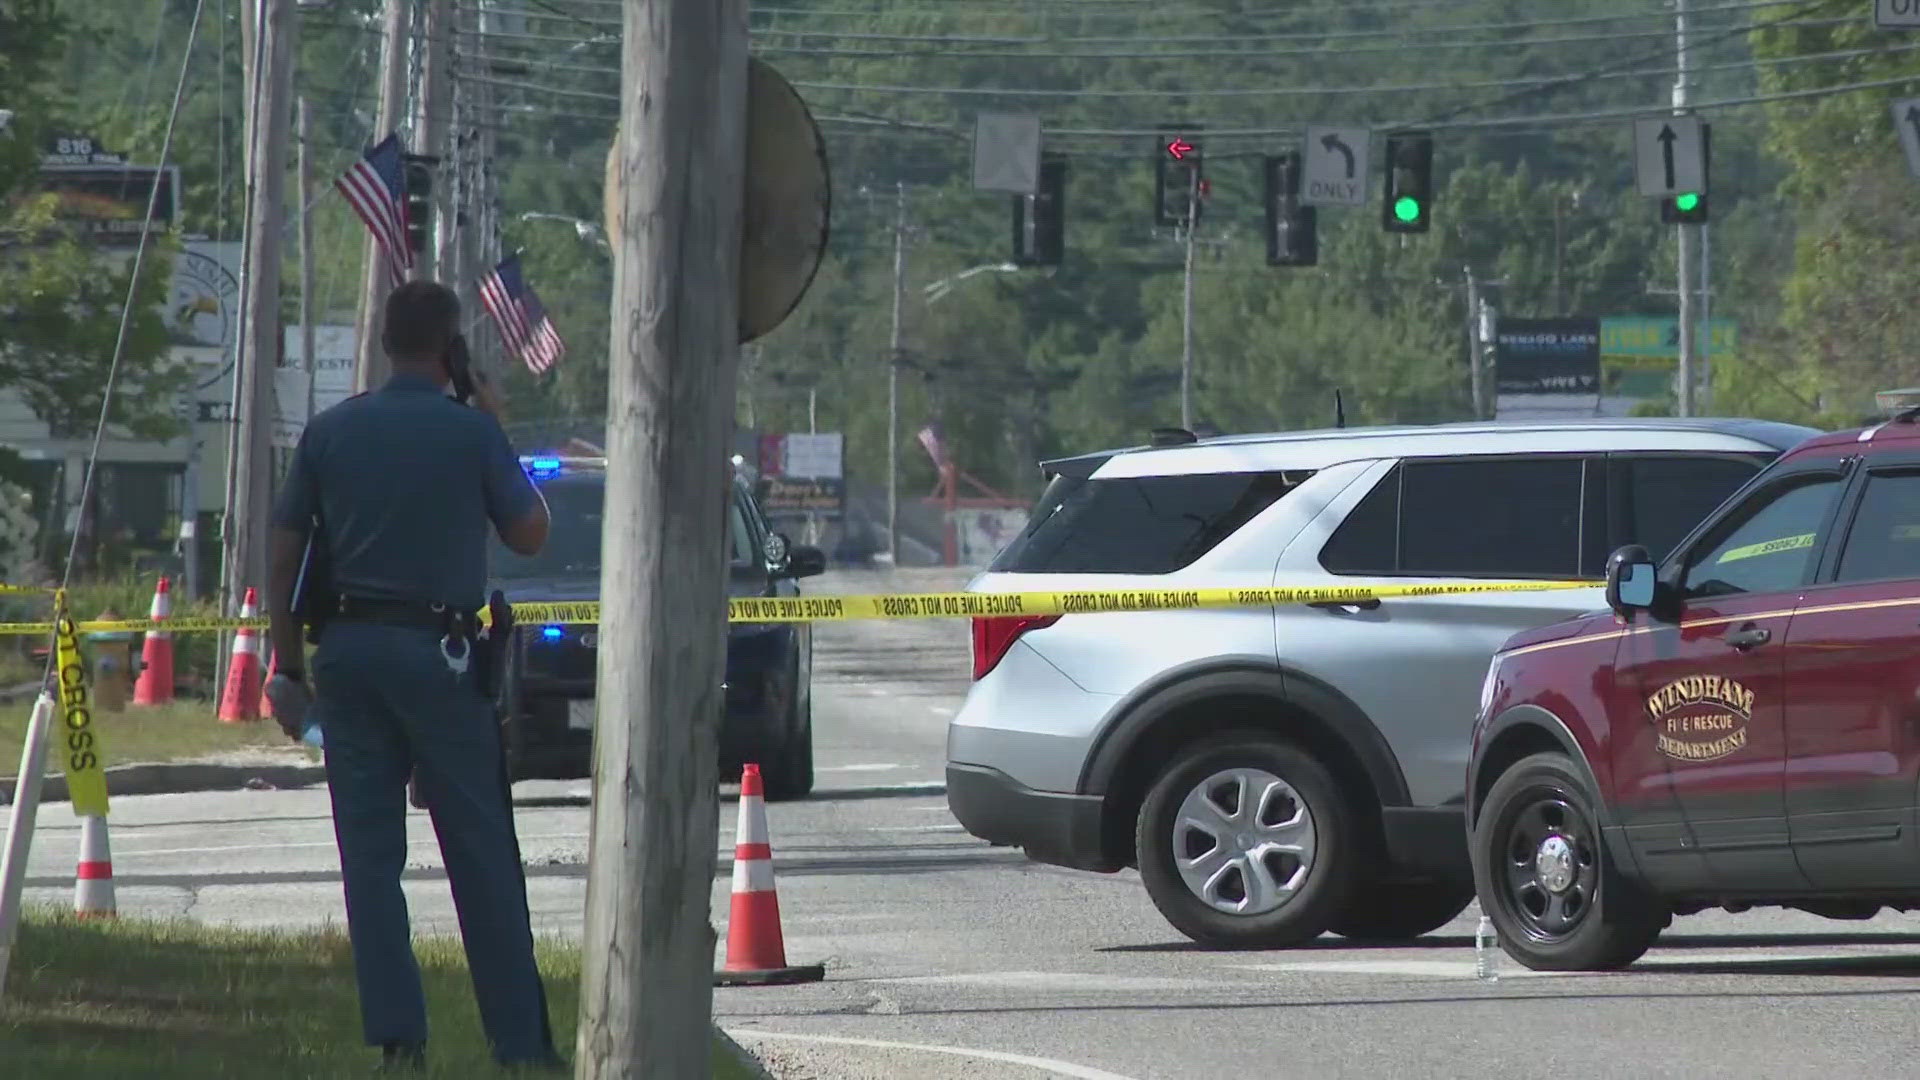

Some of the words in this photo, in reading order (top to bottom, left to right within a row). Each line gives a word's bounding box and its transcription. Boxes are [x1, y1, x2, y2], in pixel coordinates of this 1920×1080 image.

[57, 138, 93, 155] 816
[1310, 182, 1357, 199] ONLY
[1647, 674, 1754, 720] WINDHAM
[61, 664, 97, 772] CROSS
[1667, 714, 1733, 732] FIE/RESCUE
[1657, 729, 1747, 760] DEPARTMENT
